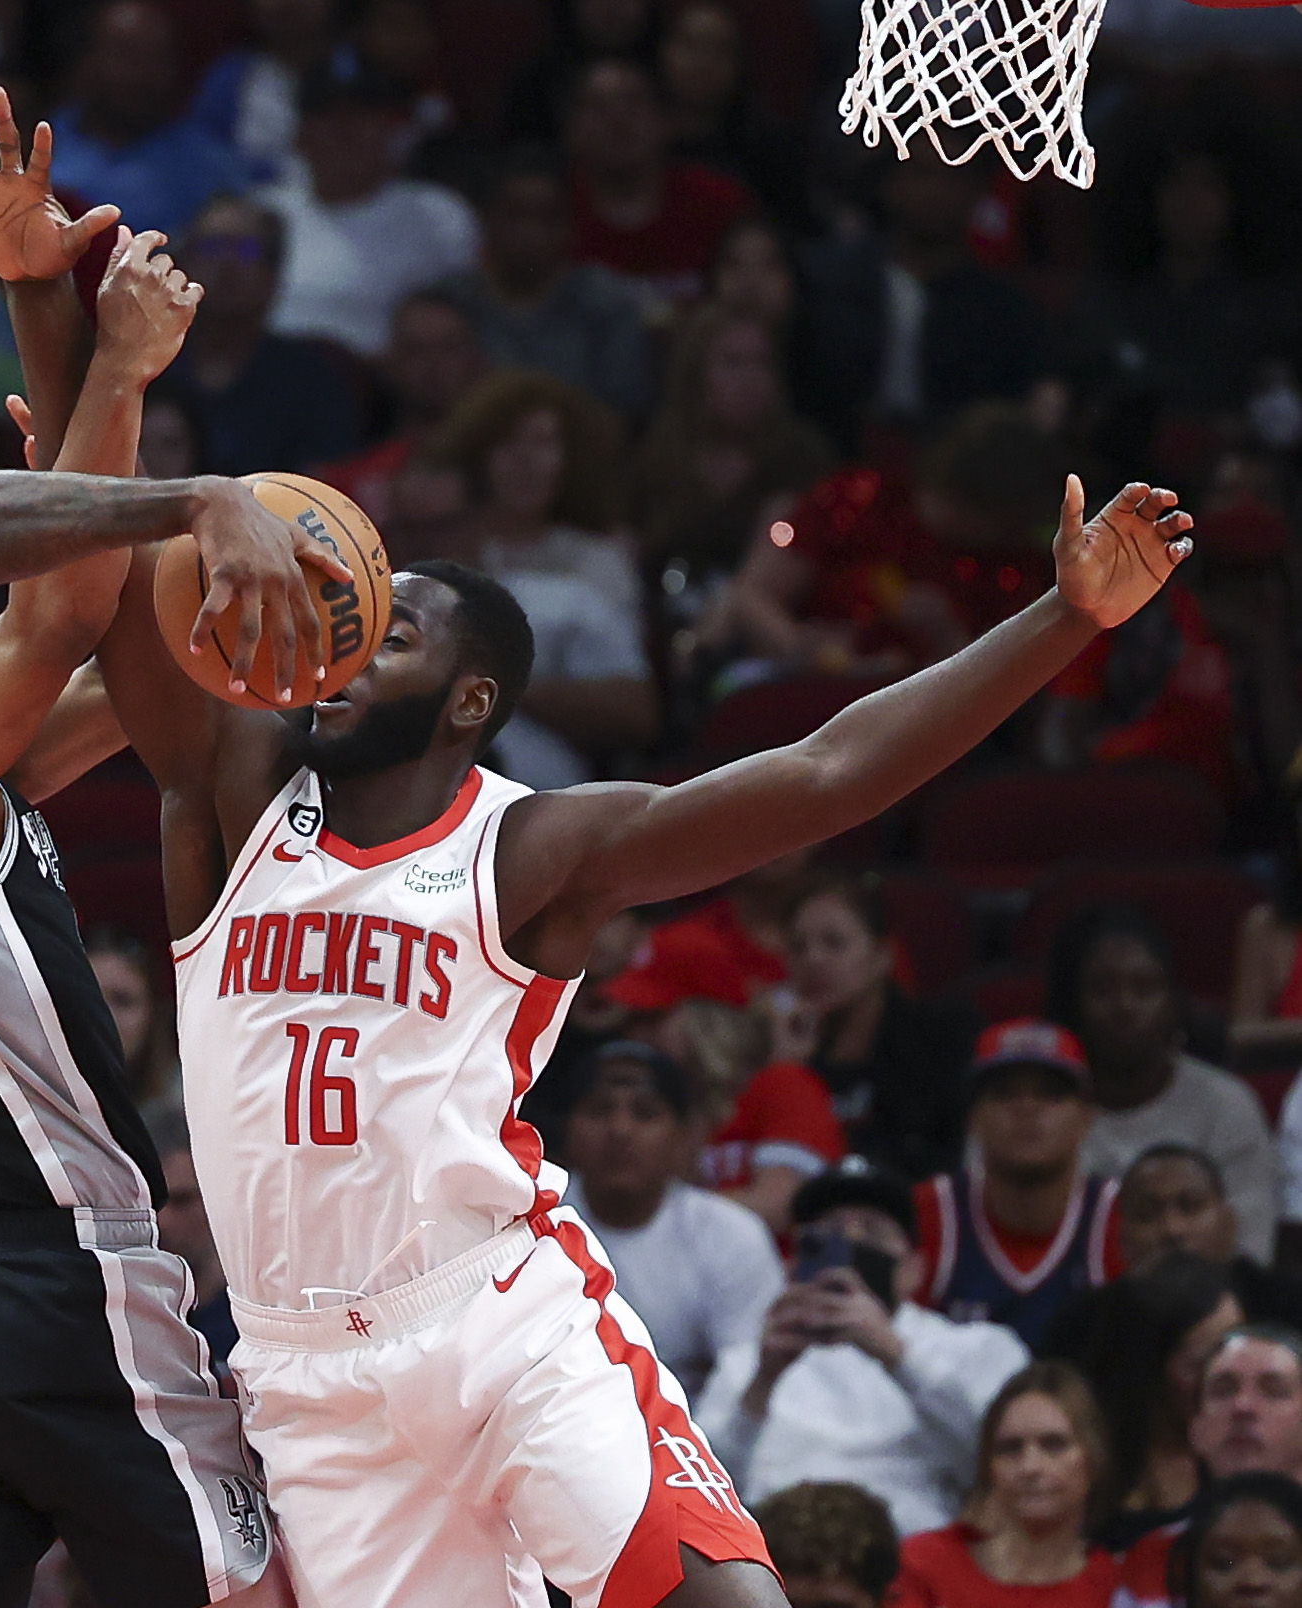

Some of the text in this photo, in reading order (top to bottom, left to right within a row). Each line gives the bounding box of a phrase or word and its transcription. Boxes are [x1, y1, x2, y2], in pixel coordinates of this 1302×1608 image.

[293, 809, 317, 834] 6
[412, 863, 467, 882] Credit
[217, 911, 458, 1021] ROCKETS
[285, 1022, 360, 1146] 16
